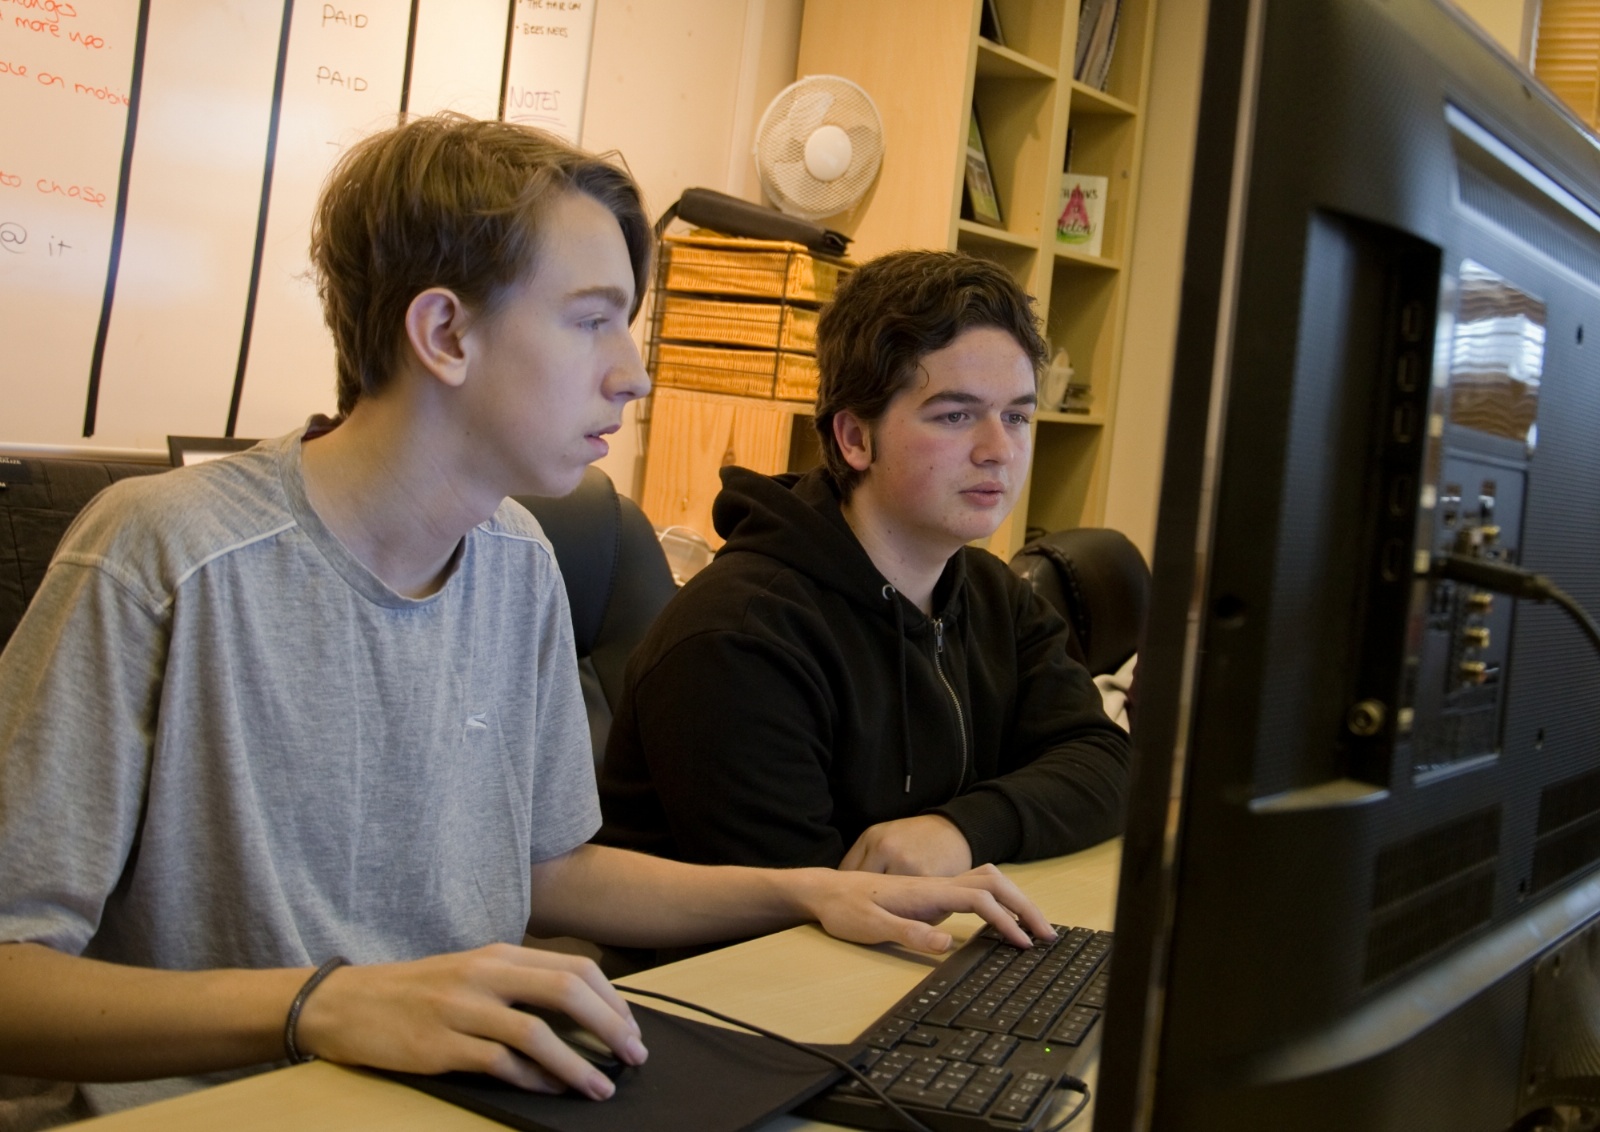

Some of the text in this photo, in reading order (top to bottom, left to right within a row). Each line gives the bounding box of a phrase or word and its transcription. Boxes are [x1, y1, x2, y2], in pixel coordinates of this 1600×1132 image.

[15, 16, 61, 38] more
[321, 3, 369, 29] PAID
[37, 72, 65, 89] on
[316, 65, 369, 92] PAID
[509, 85, 561, 111] NOTES
[48, 234, 73, 257] it
